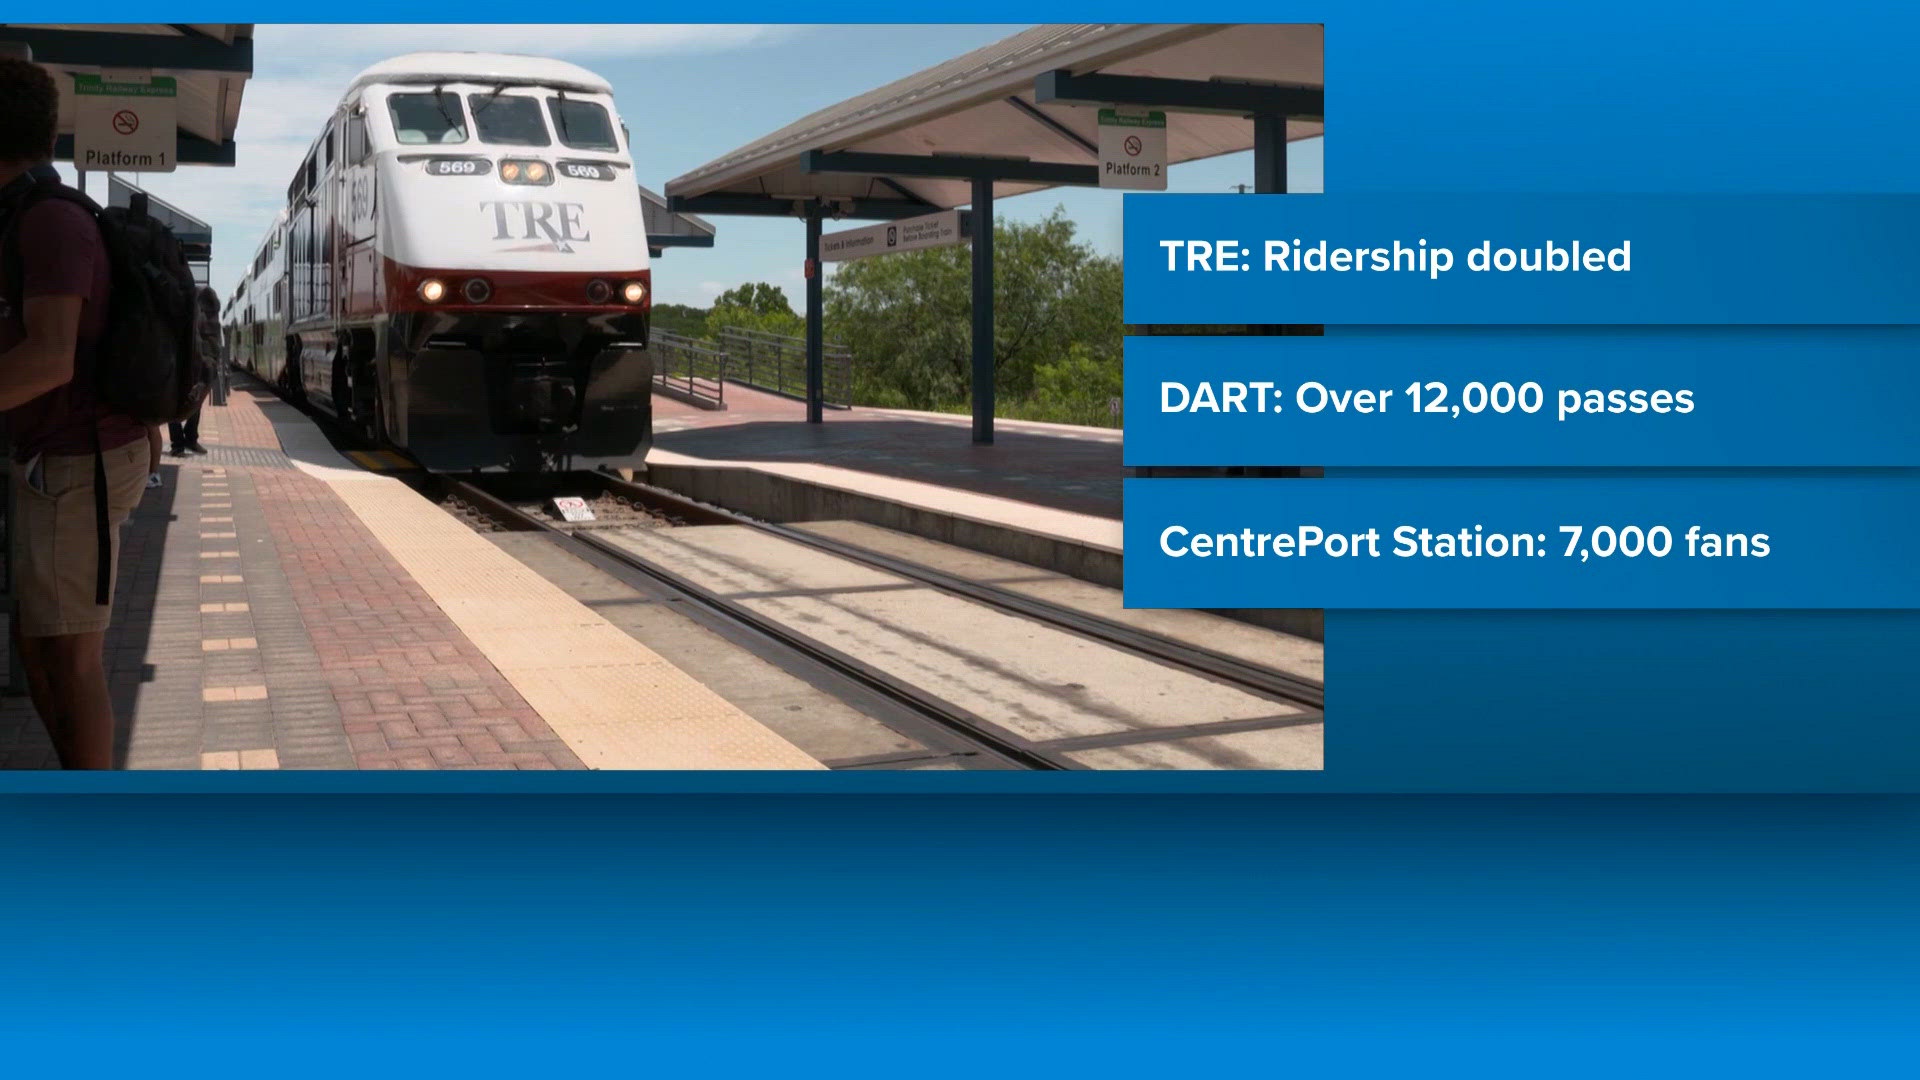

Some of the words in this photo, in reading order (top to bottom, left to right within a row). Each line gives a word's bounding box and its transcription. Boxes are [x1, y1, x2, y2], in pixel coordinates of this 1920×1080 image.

[86, 150, 152, 166] Platform
[158, 152, 165, 166] 1
[439, 161, 476, 174] 569
[567, 164, 600, 179] 569
[1106, 161, 1151, 176] Platform
[1154, 163, 1161, 177] 2
[479, 201, 590, 243] TRE
